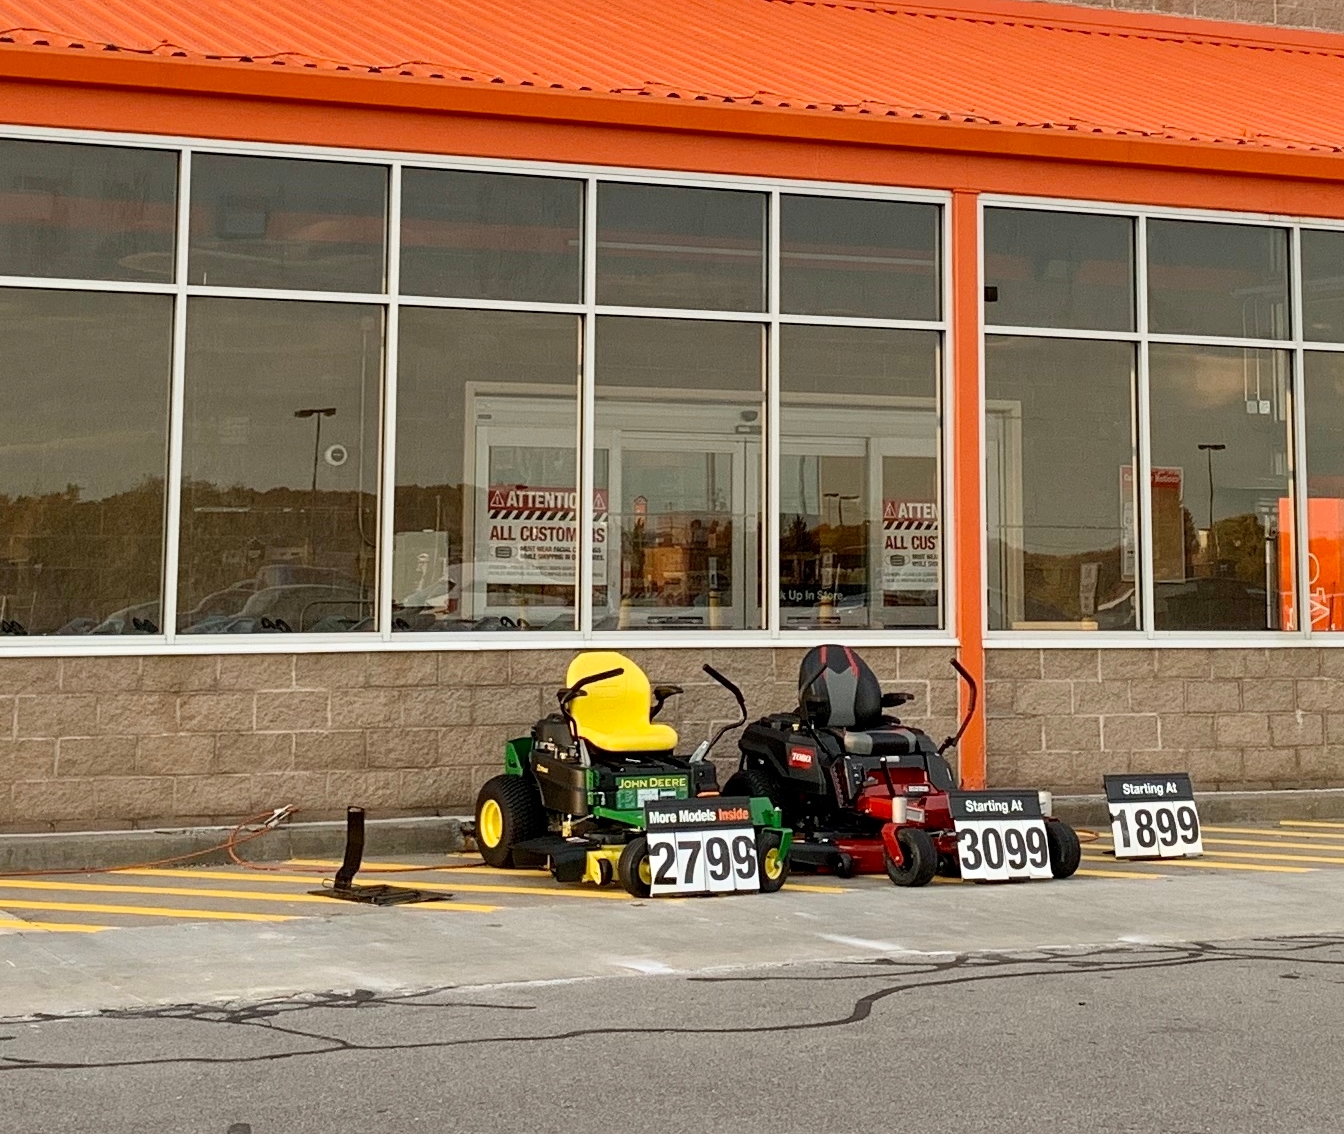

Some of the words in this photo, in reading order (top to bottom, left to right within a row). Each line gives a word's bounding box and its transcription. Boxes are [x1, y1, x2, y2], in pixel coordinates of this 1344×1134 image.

[899, 503, 938, 519] ATTEN
[490, 526, 516, 541] ALL
[520, 526, 606, 543] CUSTOMS
[885, 536, 908, 550] ALL
[911, 536, 938, 550] CUS
[788, 590, 803, 603] Up
[806, 590, 815, 600] In
[817, 589, 844, 601] Store
[619, 778, 648, 789] JOHN
[649, 777, 687, 788] DEERE
[1122, 782, 1164, 796] Starting
[1166, 781, 1178, 794] At
[965, 799, 1008, 814] Starting
[1011, 799, 1024, 812] At
[648, 810, 676, 824] More
[678, 808, 716, 823] Models
[718, 807, 749, 821] Inside
[1112, 806, 1199, 848] 1899
[959, 827, 1048, 870] 3099
[648, 835, 757, 885] 2799
